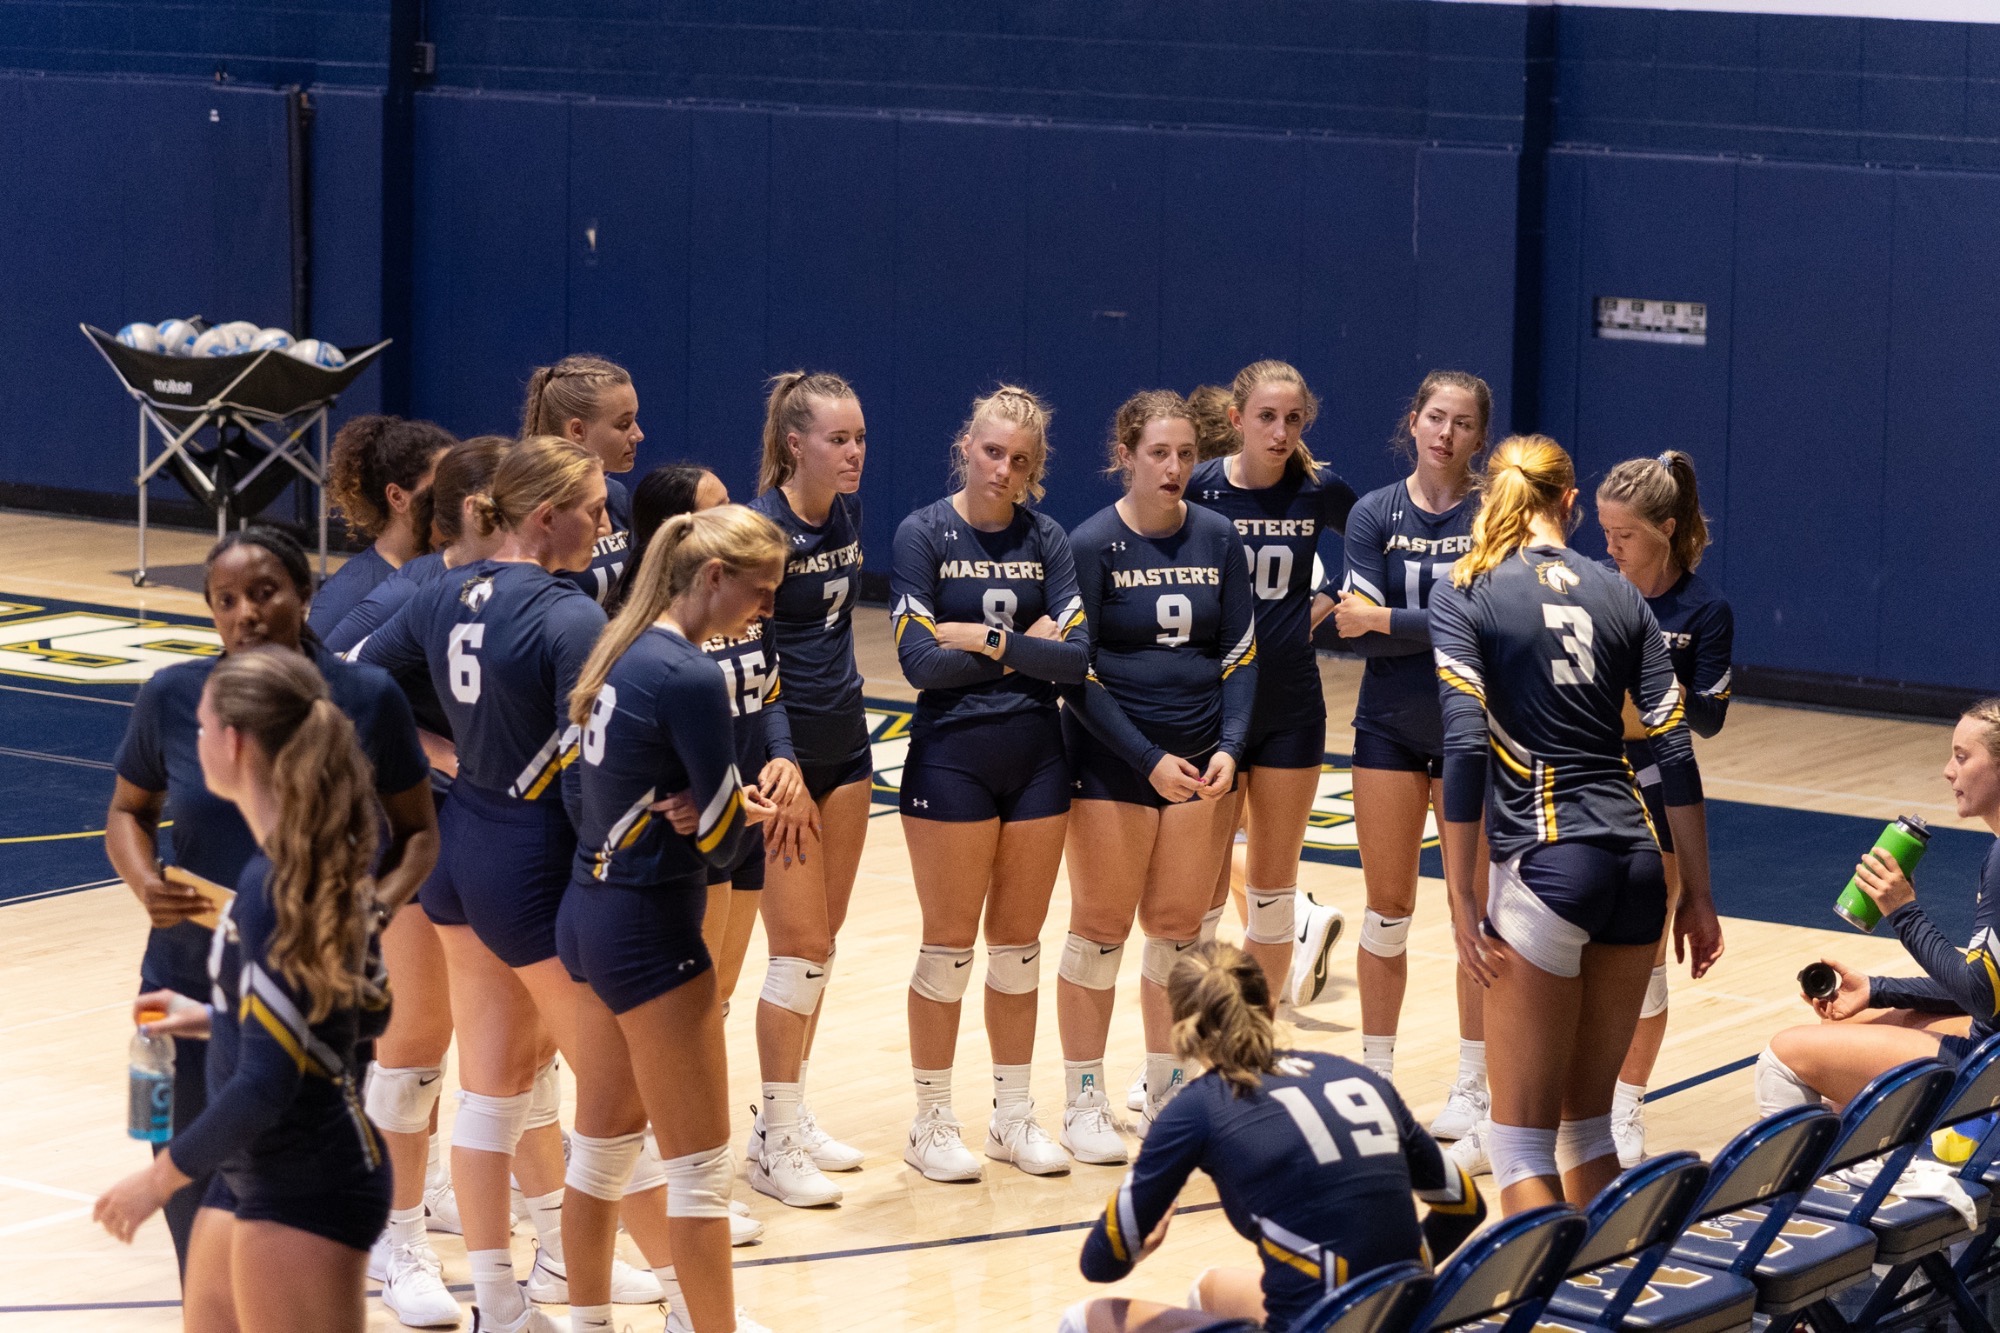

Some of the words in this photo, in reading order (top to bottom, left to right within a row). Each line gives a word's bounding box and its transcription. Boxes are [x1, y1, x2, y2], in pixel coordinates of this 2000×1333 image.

[1233, 518, 1315, 536] STER'S
[939, 560, 1045, 581] MASTER'S
[1111, 566, 1220, 588] MASTER'S
[823, 576, 850, 629] 7
[982, 588, 1018, 633] 8
[1156, 593, 1193, 648] 9
[447, 623, 486, 705] 6
[1541, 603, 1596, 684] 3
[717, 650, 767, 717] 15
[1268, 1076, 1400, 1165] 19
